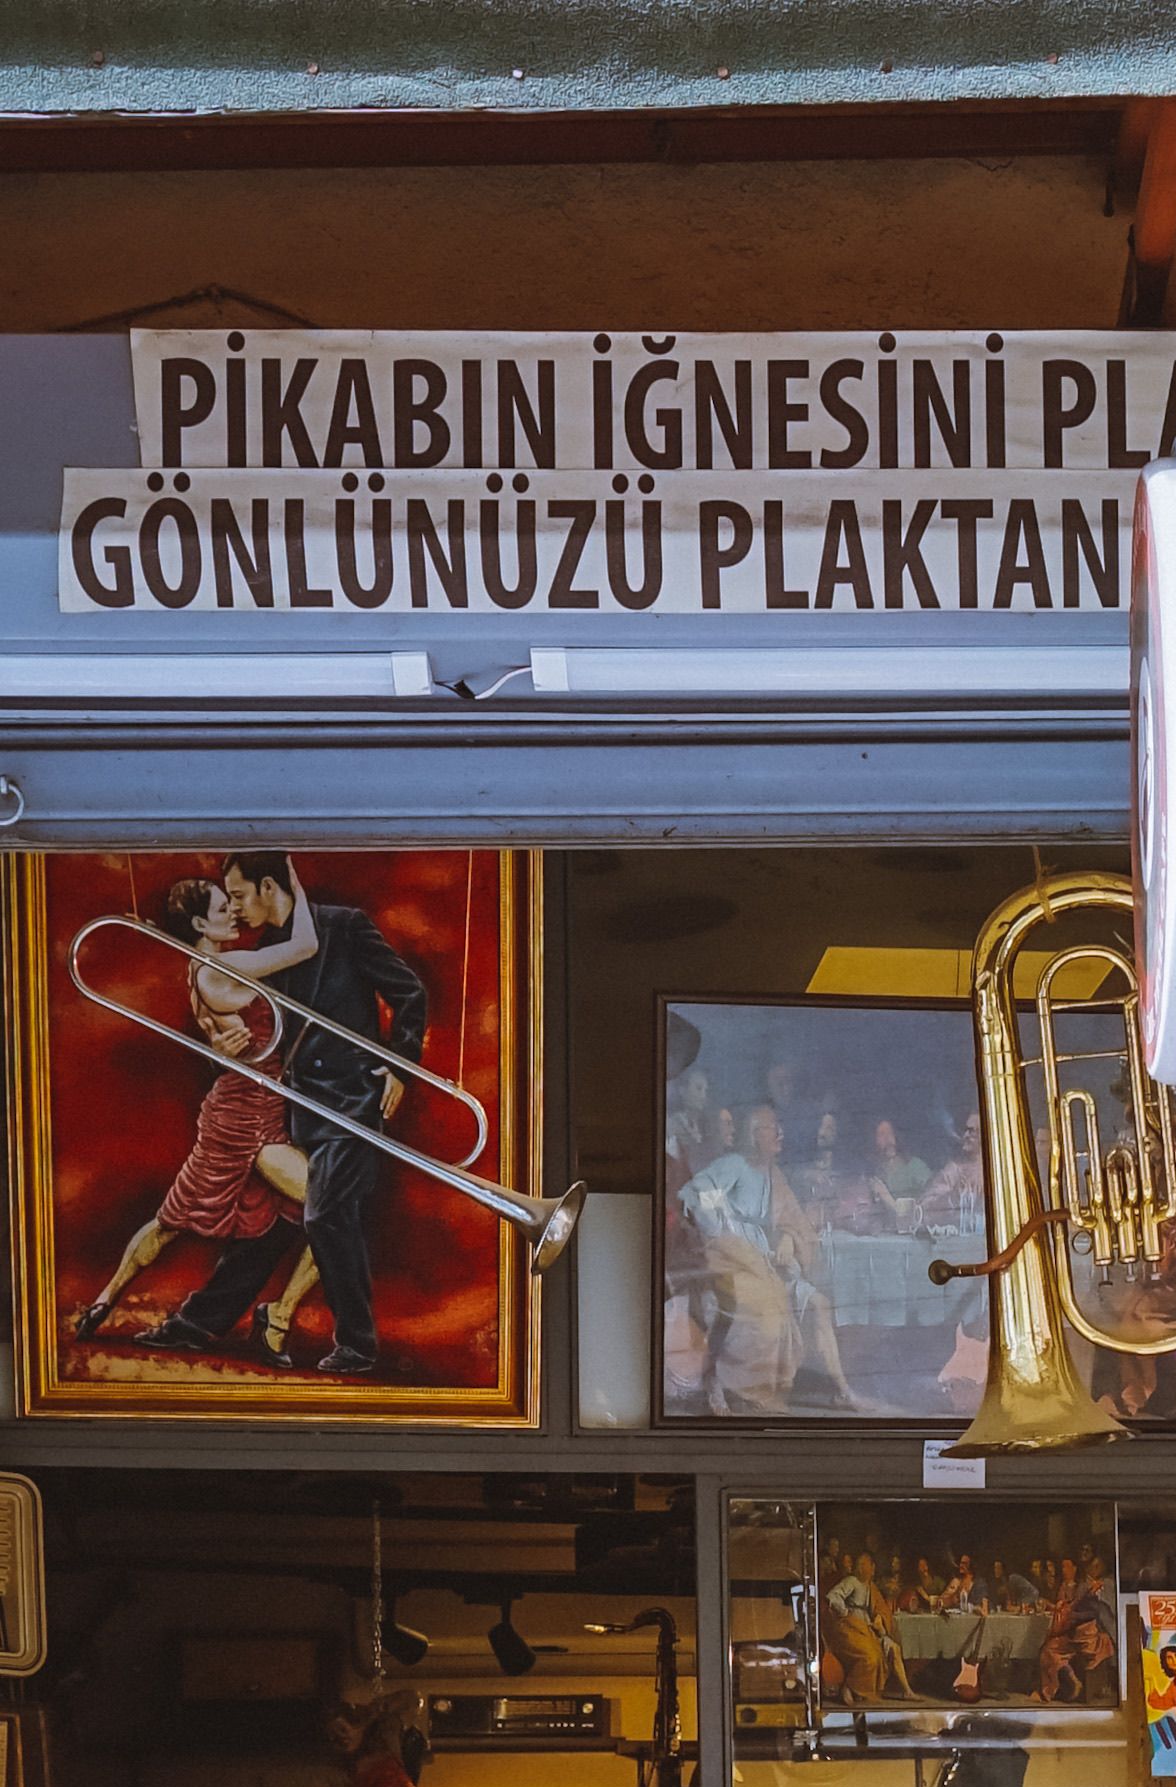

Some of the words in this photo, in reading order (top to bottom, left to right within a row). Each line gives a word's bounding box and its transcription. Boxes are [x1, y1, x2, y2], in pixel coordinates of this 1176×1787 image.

[161, 331, 556, 470] PİKABIN
[595, 333, 1002, 470] İĞNESİNİ
[71, 471, 660, 609] GÖNLÜNÜZÜ
[701, 499, 1119, 608] PLAKTAN
